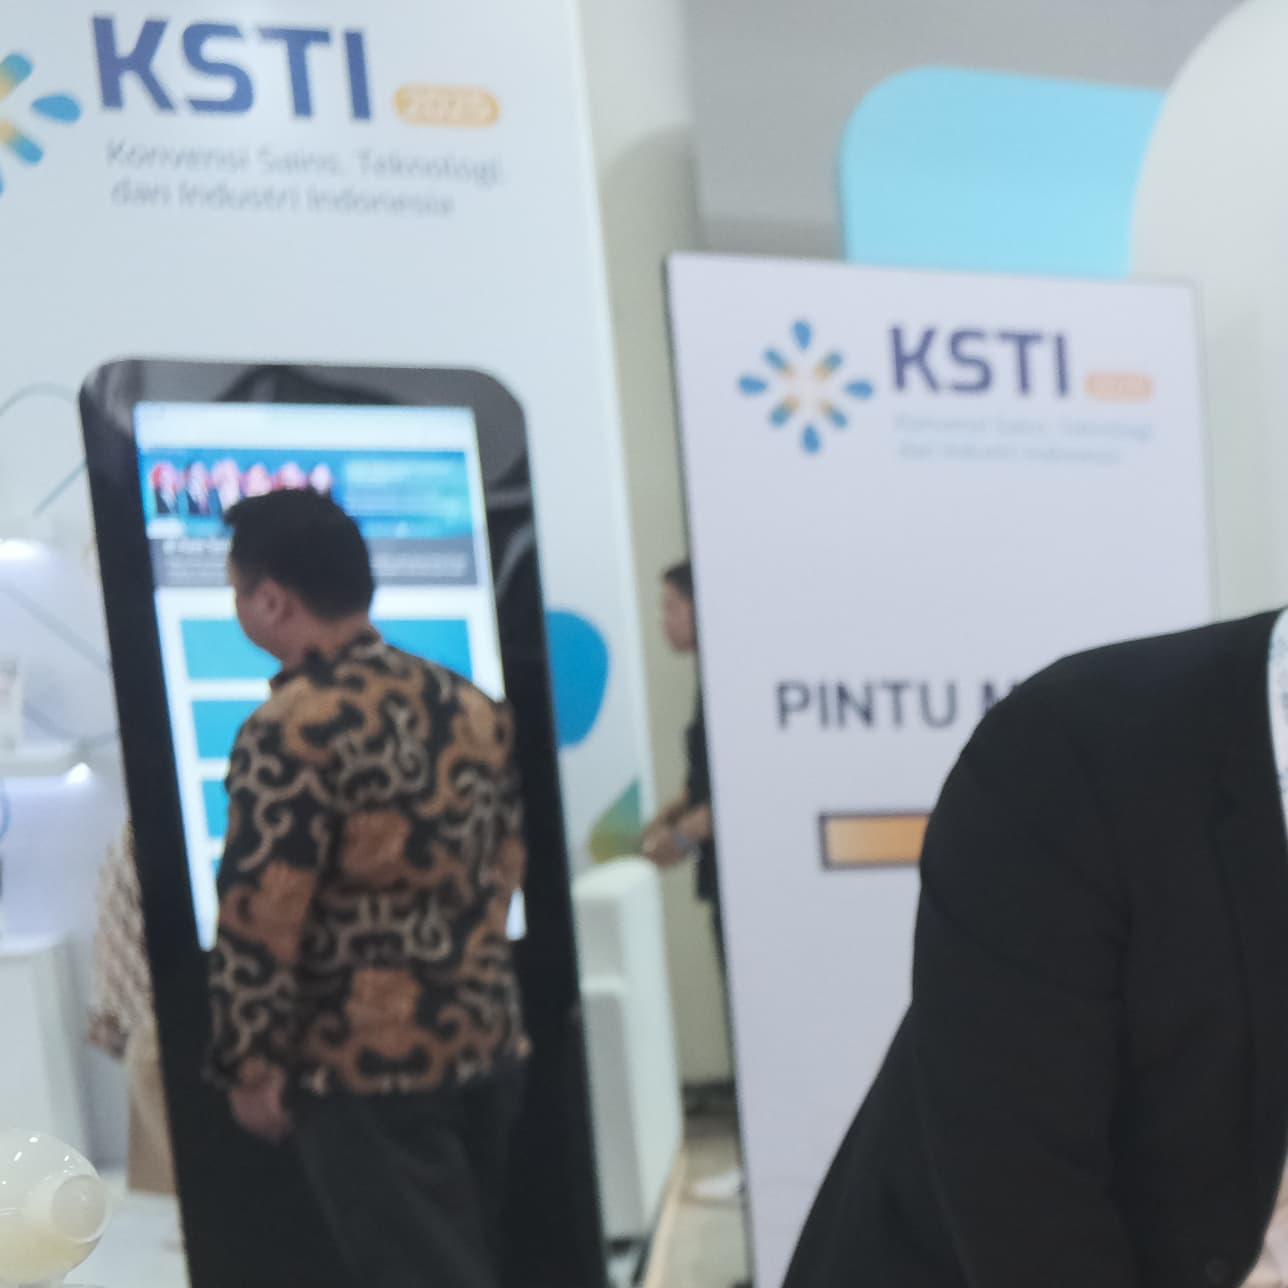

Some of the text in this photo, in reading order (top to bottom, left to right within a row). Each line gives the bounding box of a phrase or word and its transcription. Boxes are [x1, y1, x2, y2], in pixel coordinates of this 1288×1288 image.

[92, 15, 374, 121] KSTI
[890, 327, 1070, 397] KSTI
[775, 679, 959, 730] PINTU
